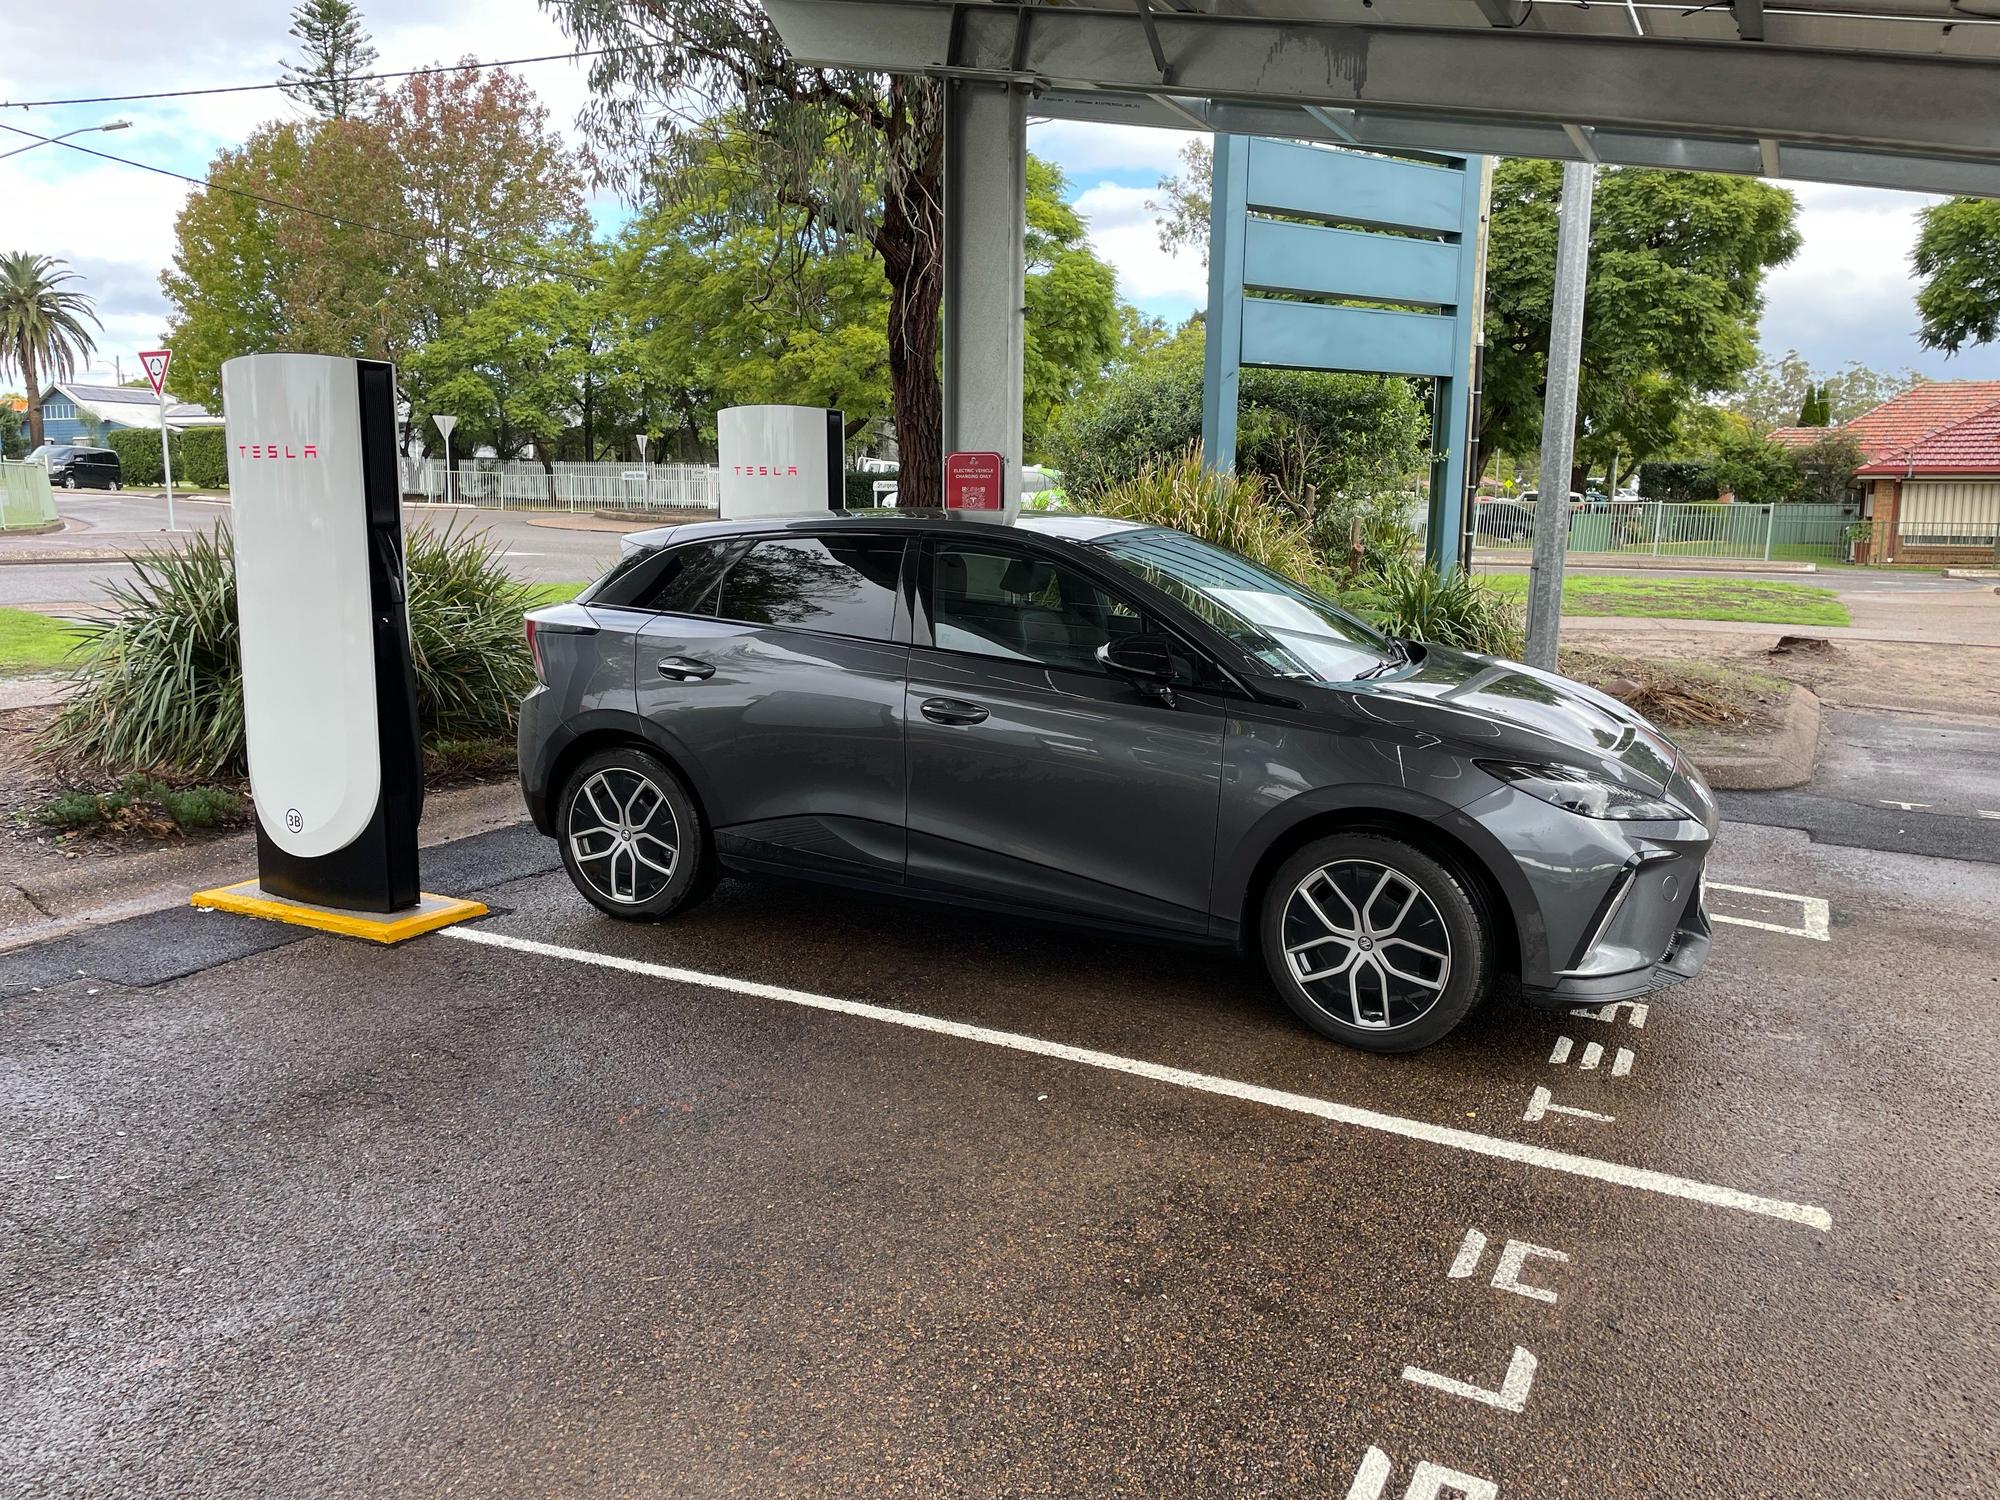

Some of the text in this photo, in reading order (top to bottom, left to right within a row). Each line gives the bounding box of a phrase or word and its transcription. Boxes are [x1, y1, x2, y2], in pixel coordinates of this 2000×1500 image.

[239, 445, 317, 459] TESLA
[734, 465, 798, 476] TESLA
[288, 814, 301, 828] 3B
